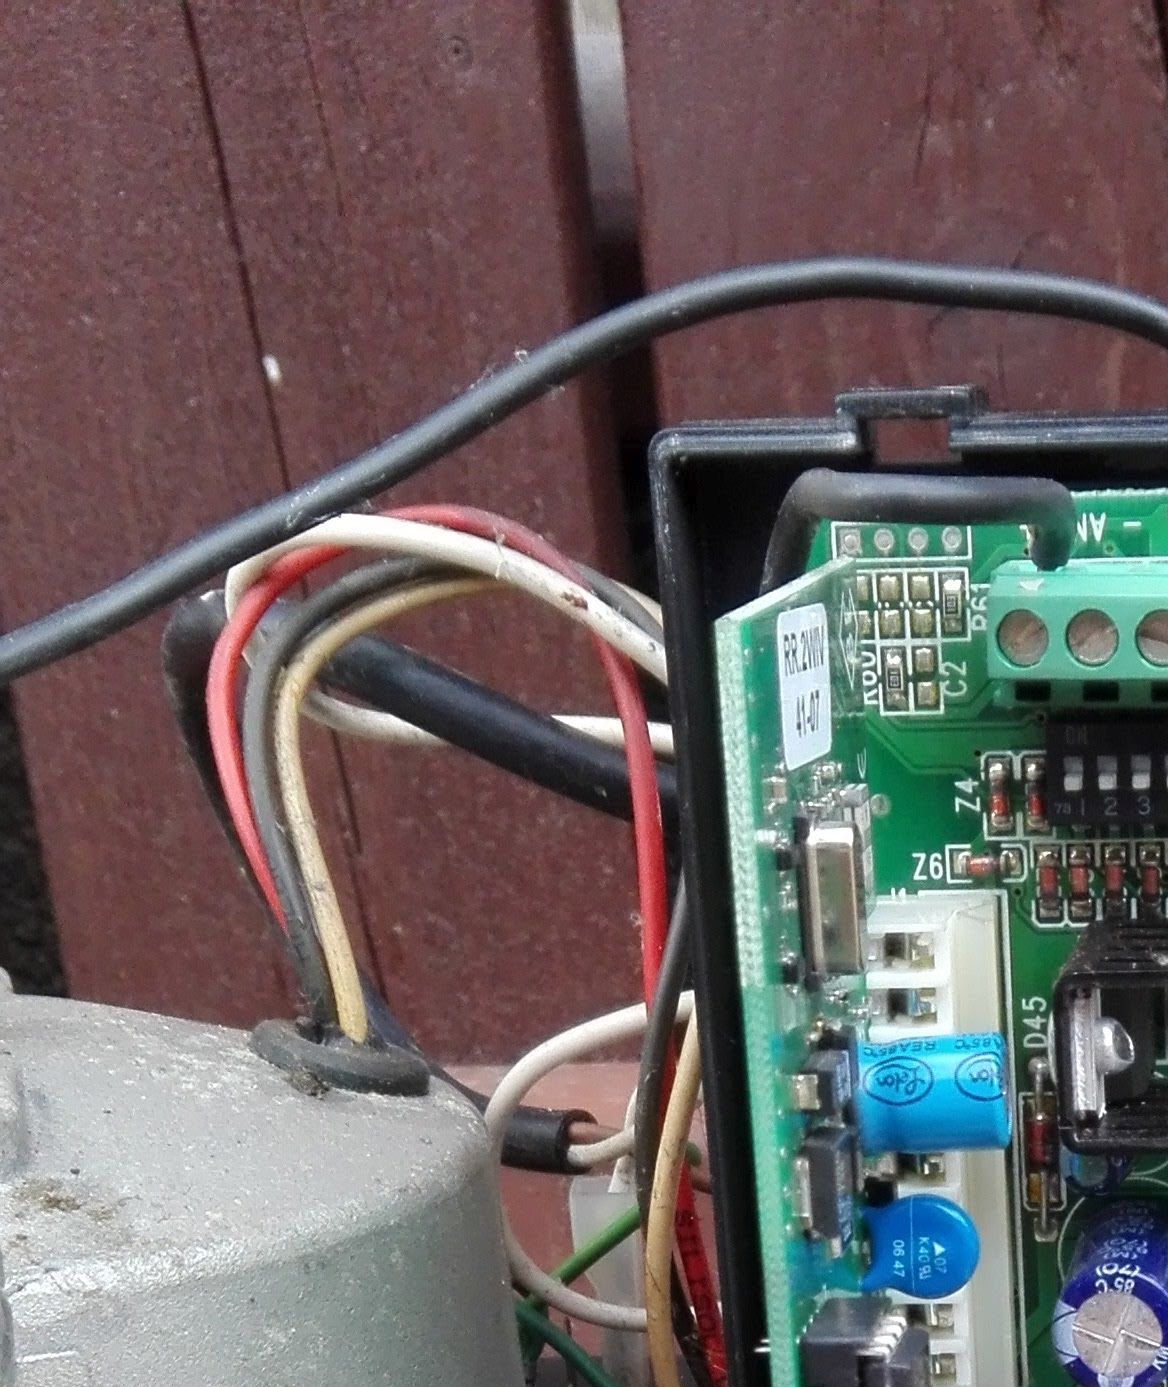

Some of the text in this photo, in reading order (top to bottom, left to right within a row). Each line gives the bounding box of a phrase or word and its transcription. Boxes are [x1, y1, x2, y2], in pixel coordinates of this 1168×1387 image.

[943, 661, 967, 697] C2
[955, 778, 981, 813] Z4
[1104, 798, 1118, 816] 2
[1138, 796, 1151, 815] 3
[912, 852, 943, 880] Z6
[1022, 996, 1048, 1049] D45
